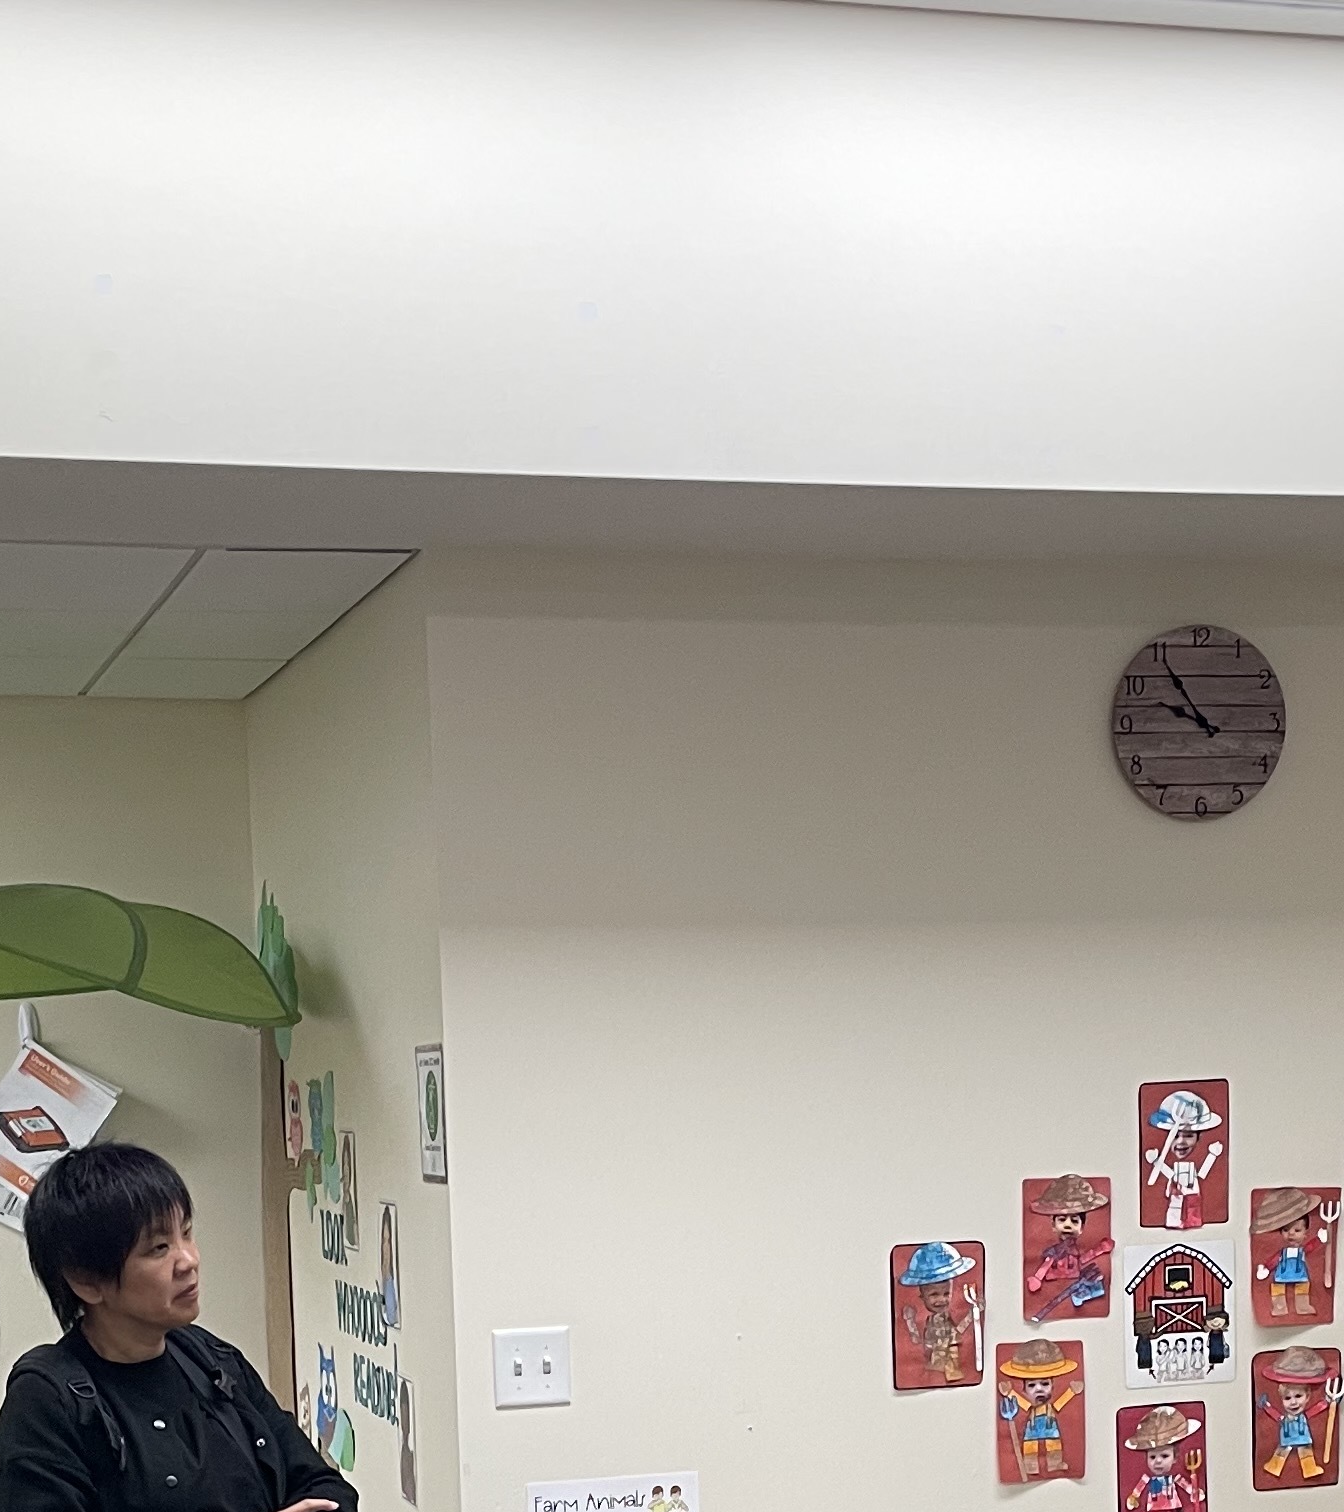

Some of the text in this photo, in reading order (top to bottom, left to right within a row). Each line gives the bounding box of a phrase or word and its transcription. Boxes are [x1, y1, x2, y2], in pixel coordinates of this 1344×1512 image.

[1190, 627, 1211, 647] 12
[1153, 641, 1167, 662] 11
[1233, 638, 1241, 658] 1
[1125, 675, 1145, 696] 10
[1259, 668, 1272, 689] 2
[1119, 714, 1133, 735] 9
[1269, 712, 1281, 732] 3
[1130, 754, 1143, 775] 8
[1258, 753, 1268, 774] 4
[1156, 784, 1168, 806] 7
[1232, 784, 1243, 805] 5
[1194, 796, 1207, 817] 6
[320, 1209, 348, 1266] LOOK
[586, 1490, 646, 1511] Animals
